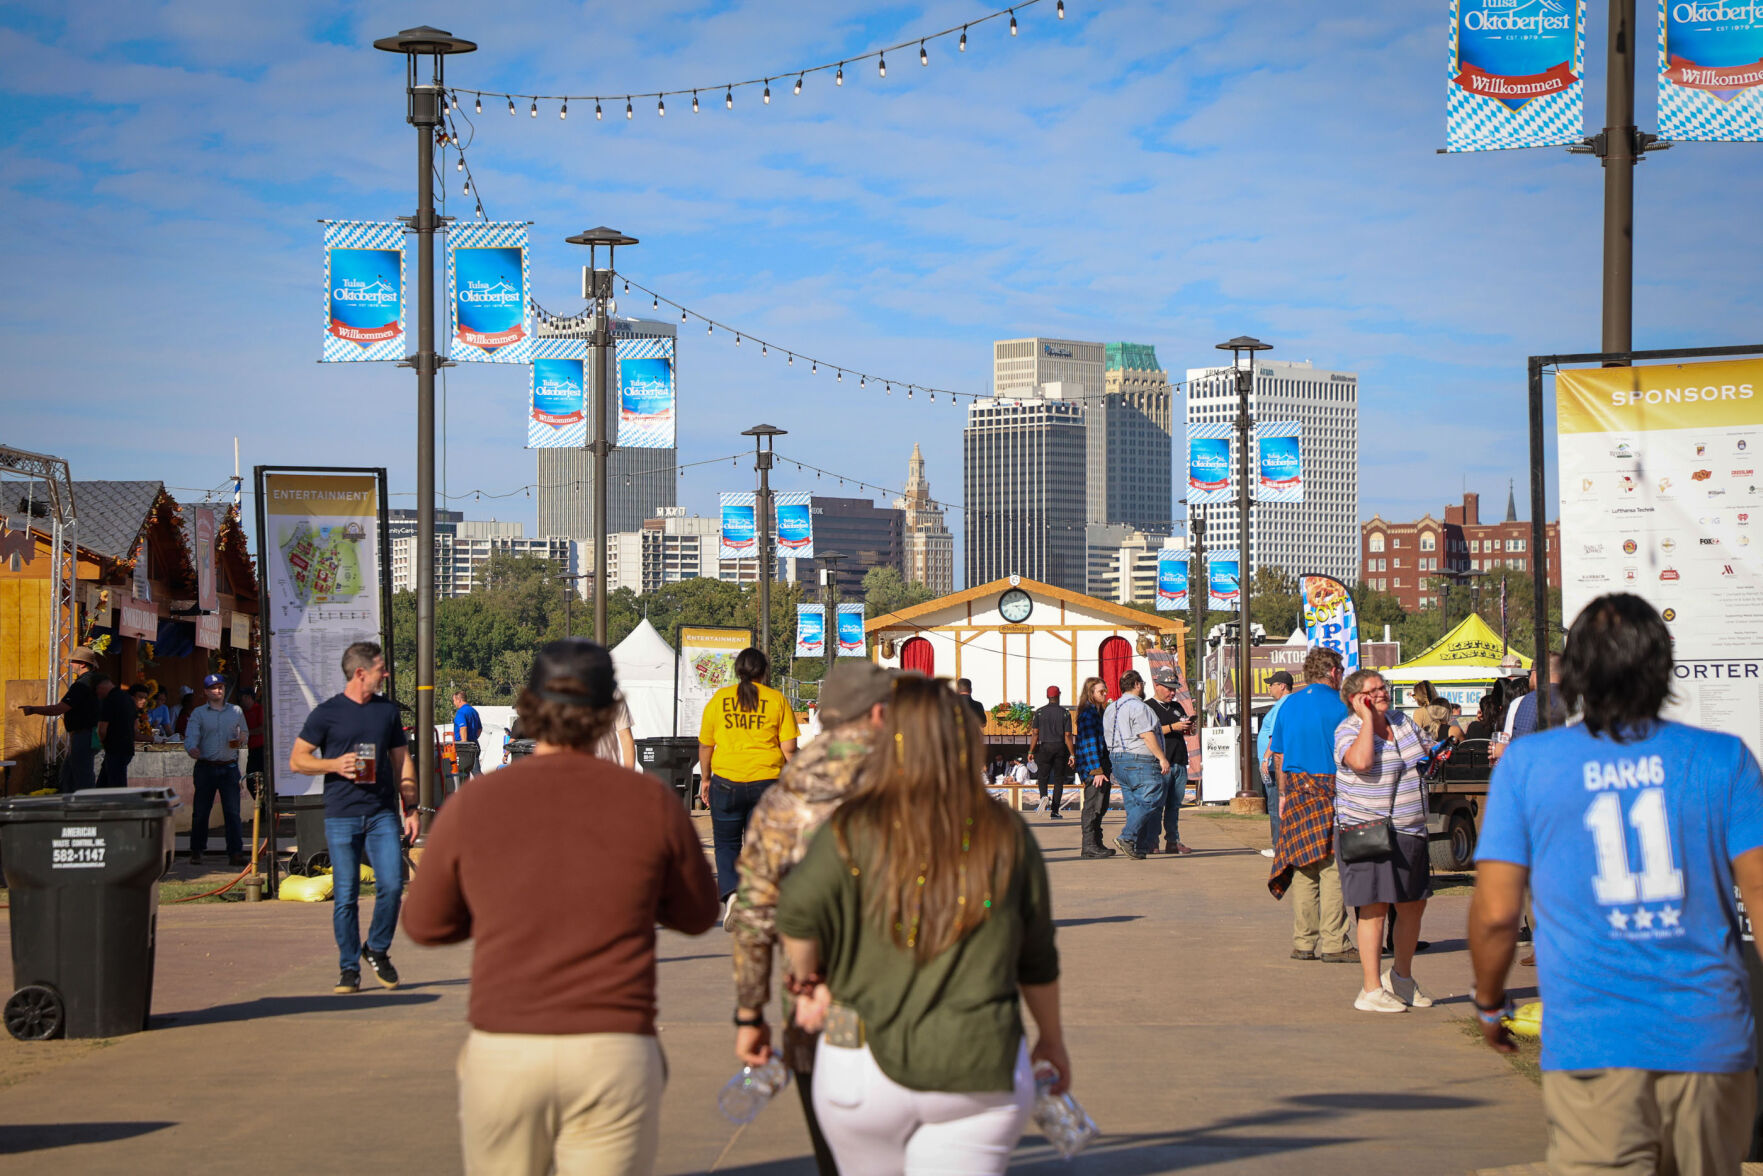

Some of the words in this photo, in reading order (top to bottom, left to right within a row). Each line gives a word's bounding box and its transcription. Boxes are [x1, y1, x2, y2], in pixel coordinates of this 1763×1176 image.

[1672, 0, 1763, 24] Oktoberfe
[1464, 8, 1571, 34] Oktoberfest
[1471, 74, 1563, 95] Willkommen
[342, 278, 366, 287] Tulsa
[467, 280, 490, 289] Tulsa
[333, 287, 397, 304] Oktoberfest
[459, 288, 520, 304] Oktoberfest
[338, 326, 394, 340] Willkommen
[465, 332, 519, 345] Willkommen
[536, 386, 582, 398] Oktoberfest
[623, 385, 669, 397] Oktoberfest
[1611, 383, 1754, 407] SPONSORS
[539, 413, 578, 423] Willkommen
[272, 488, 370, 502] ENTERTAINMENT
[1304, 595, 1349, 627] SOFT
[686, 634, 747, 643] ENTERTAINMENT
[1673, 664, 1759, 679] ORTER
[1466, 691, 1482, 704] ICE
[724, 713, 767, 730] STAFF
[1582, 754, 1666, 792] BAR46
[61, 826, 97, 838] AMERICAN
[1582, 786, 1685, 907] 11
[53, 848, 106, 862] 582-1147
